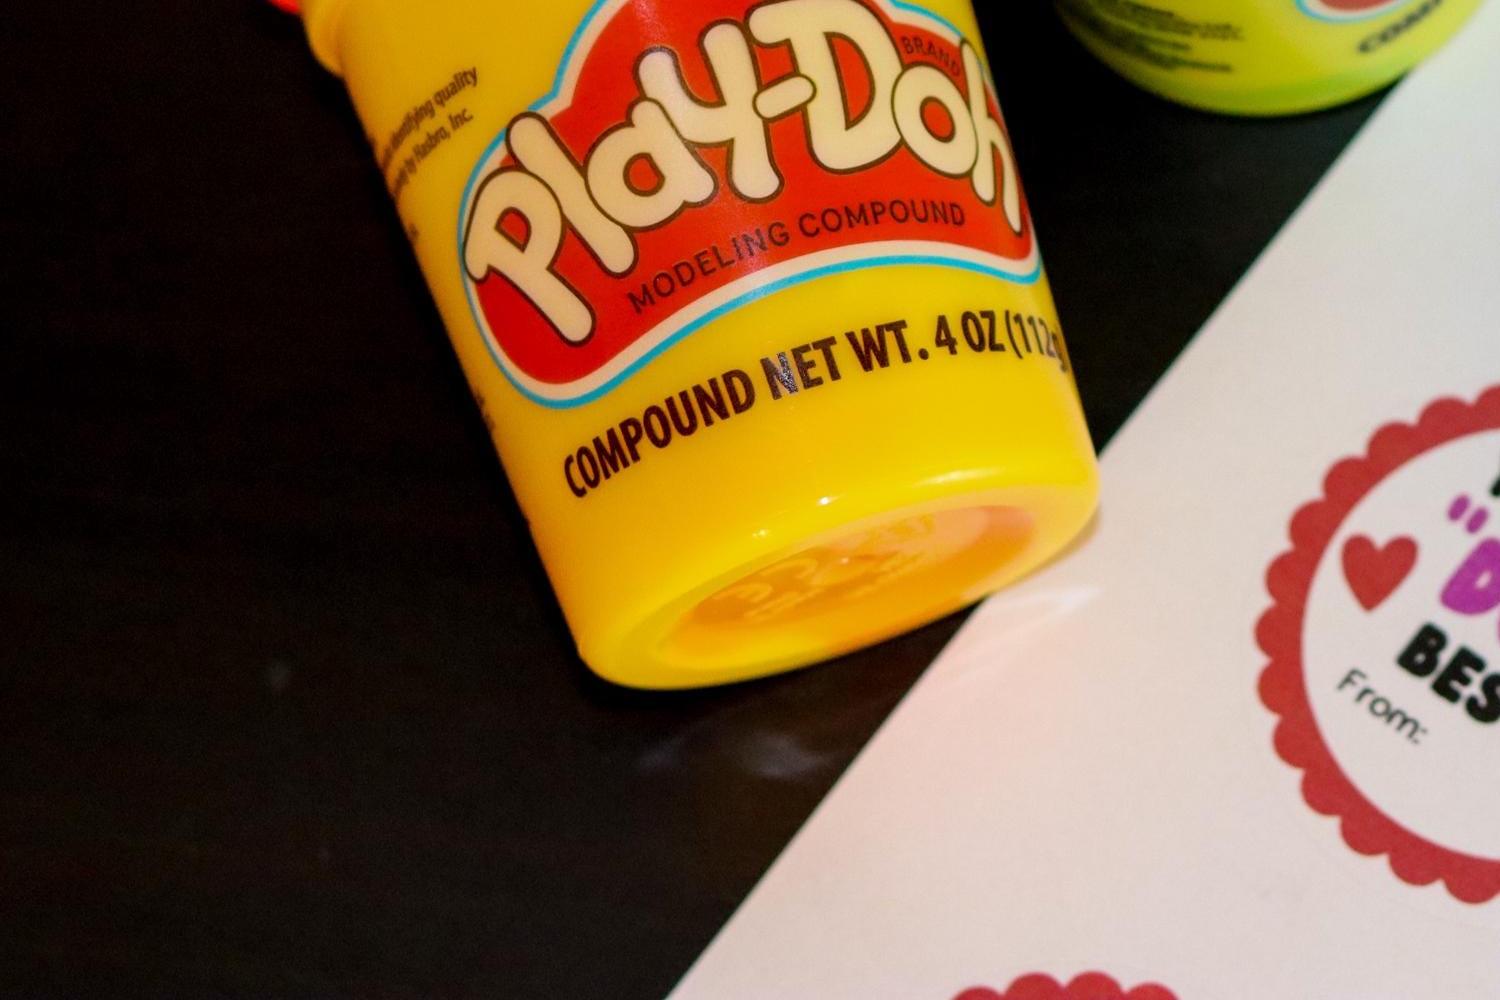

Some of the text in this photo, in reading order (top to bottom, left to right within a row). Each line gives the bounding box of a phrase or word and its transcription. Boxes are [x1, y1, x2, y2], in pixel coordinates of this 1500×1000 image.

[902, 34, 961, 78] BRAND
[433, 66, 478, 107] quality
[448, 108, 475, 132] Inc.
[627, 200, 966, 314] MODELING COMPOUND
[563, 368, 757, 499] COMPOUND
[760, 336, 843, 400] NET
[845, 319, 929, 362] WT.
[935, 315, 957, 355] 4
[962, 310, 1005, 354] OZ
[1337, 668, 1428, 745] From:
